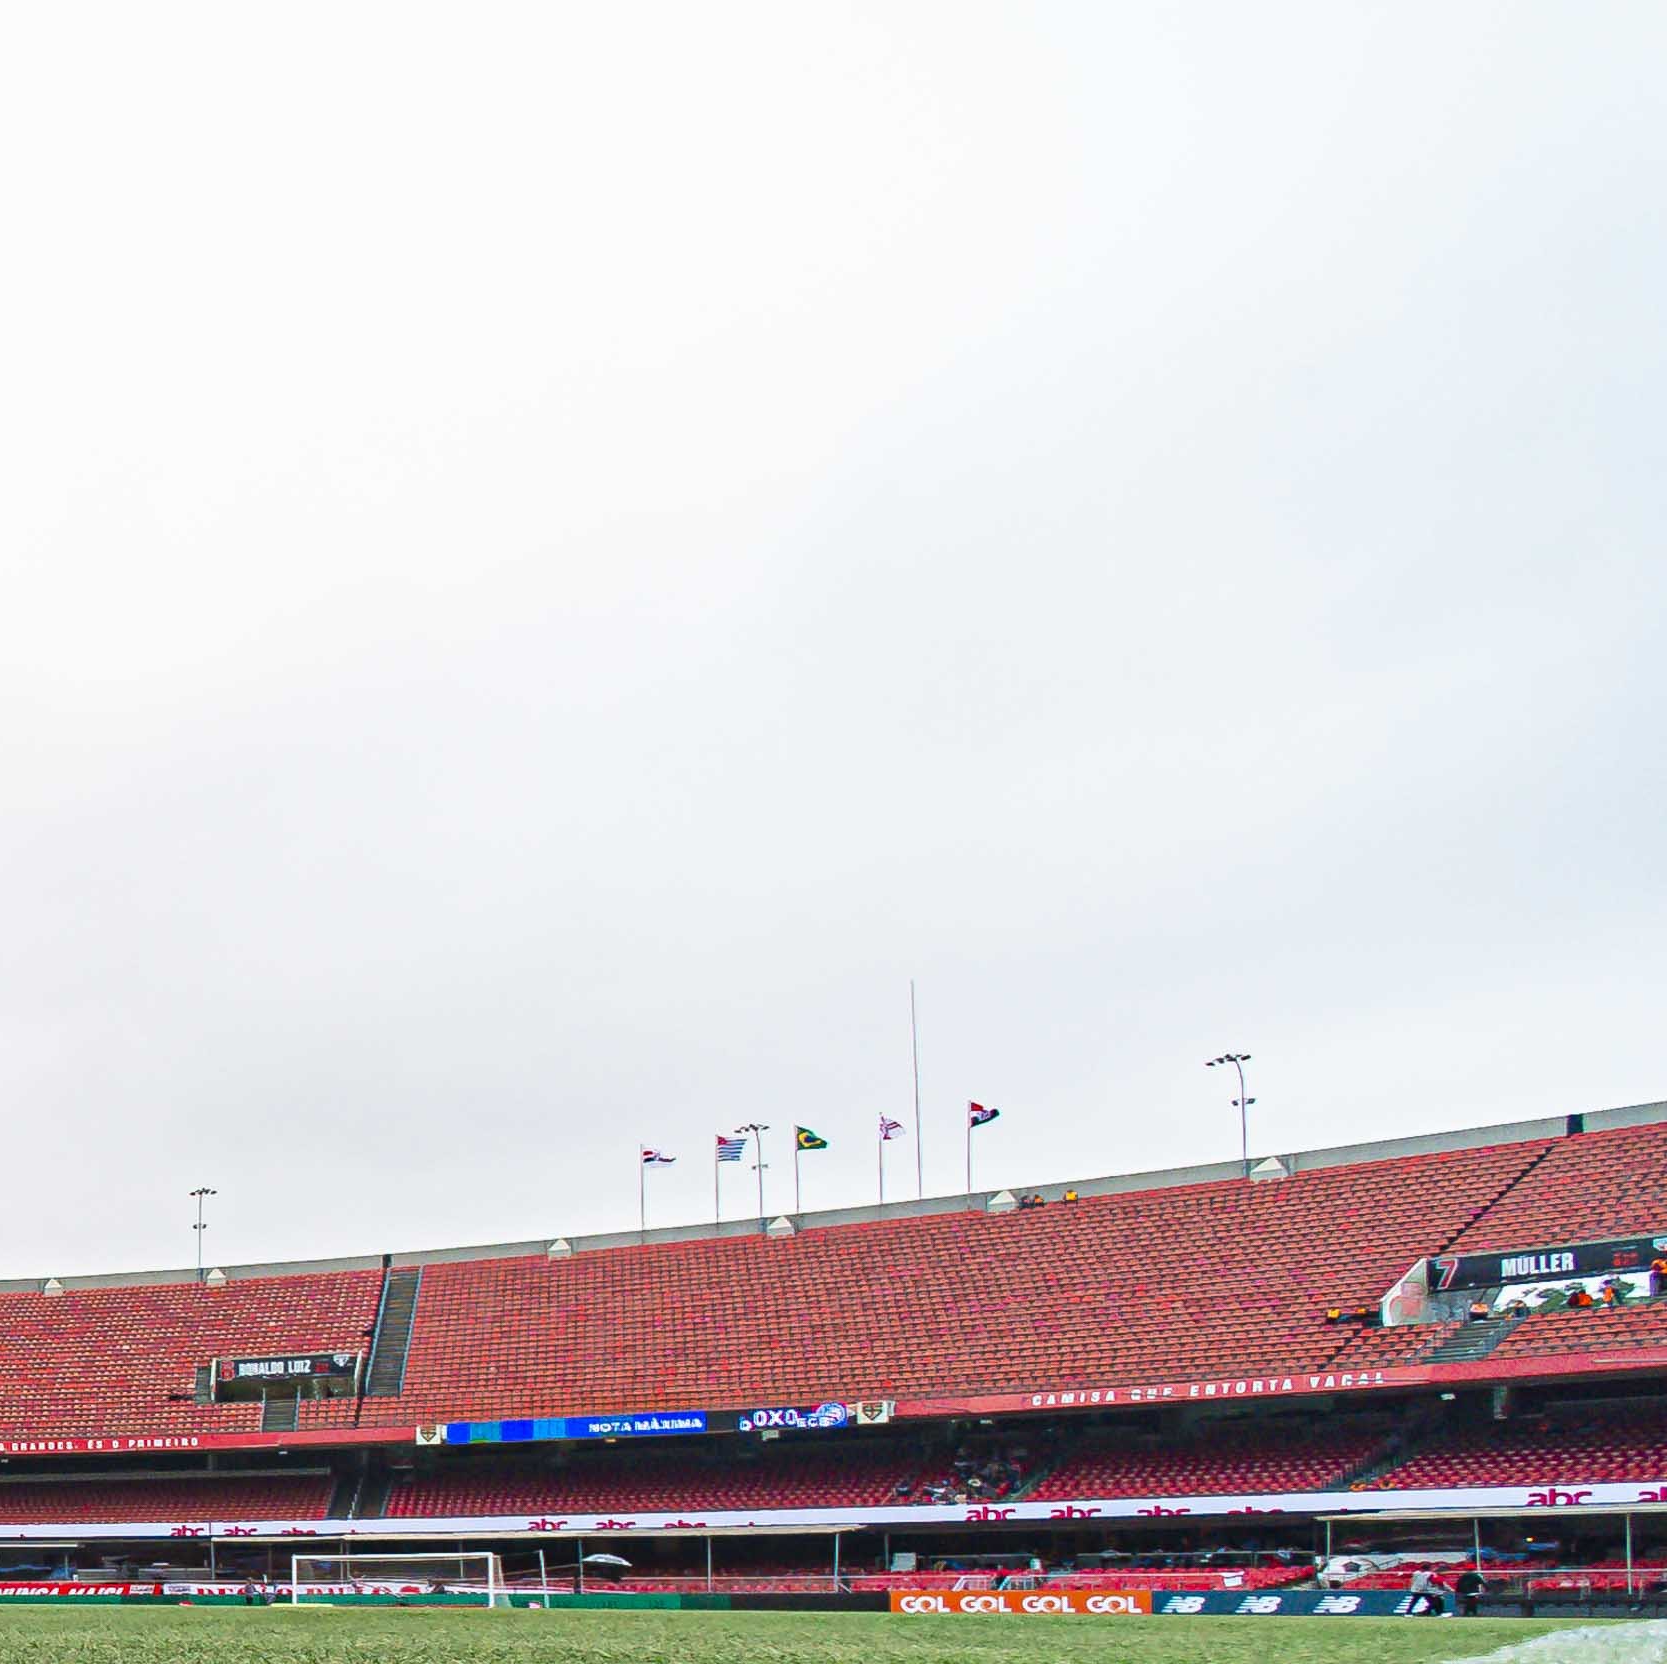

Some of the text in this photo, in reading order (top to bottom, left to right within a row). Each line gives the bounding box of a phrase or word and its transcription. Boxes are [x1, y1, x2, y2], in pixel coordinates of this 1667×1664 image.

[1501, 1252, 1575, 1278] MÜLLER
[1436, 1258, 1458, 1290] 7
[288, 1360, 311, 1373] LUIZ
[1032, 1391, 1115, 1406] CAMISA
[1190, 1378, 1293, 1397] ENTORTA
[589, 1421, 632, 1433] NOTA
[128, 1437, 198, 1448] PRIMEIRO
[1526, 1488, 1593, 1506] abc
[965, 1506, 1016, 1521] abc
[170, 1525, 204, 1537] abc
[527, 1518, 568, 1531] abc
[900, 1595, 951, 1613] GOL
[959, 1596, 1012, 1613] GOL
[1022, 1596, 1075, 1614] GOL
[1086, 1595, 1142, 1614] GOL
